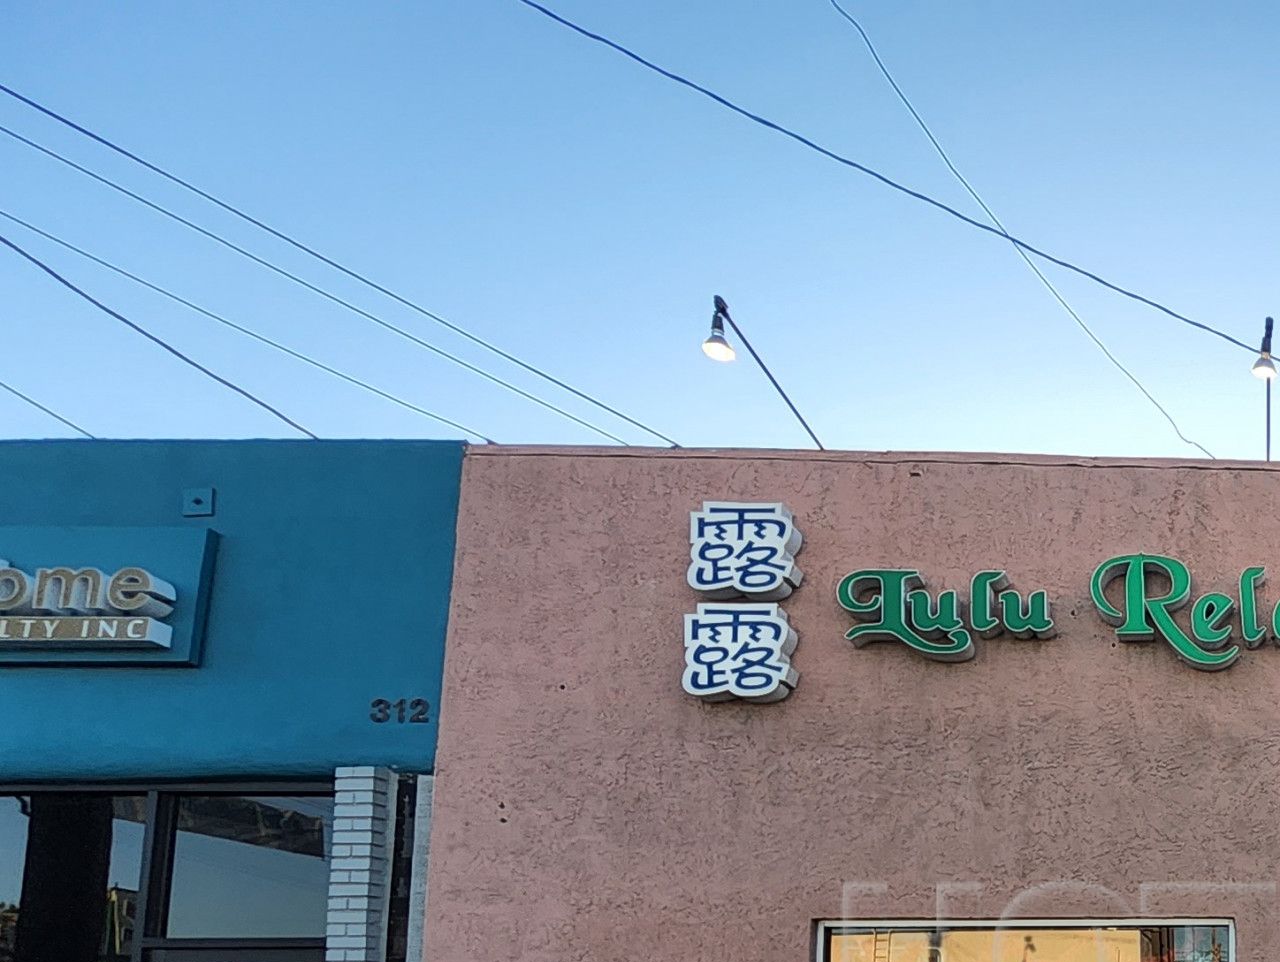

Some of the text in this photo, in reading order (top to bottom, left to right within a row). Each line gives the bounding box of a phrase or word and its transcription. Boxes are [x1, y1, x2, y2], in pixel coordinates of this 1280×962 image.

[0, 563, 164, 614] ome
[690, 504, 788, 692] 露露
[836, 568, 1053, 658] Lulu
[80, 619, 145, 638] INC
[369, 698, 430, 724] 312
